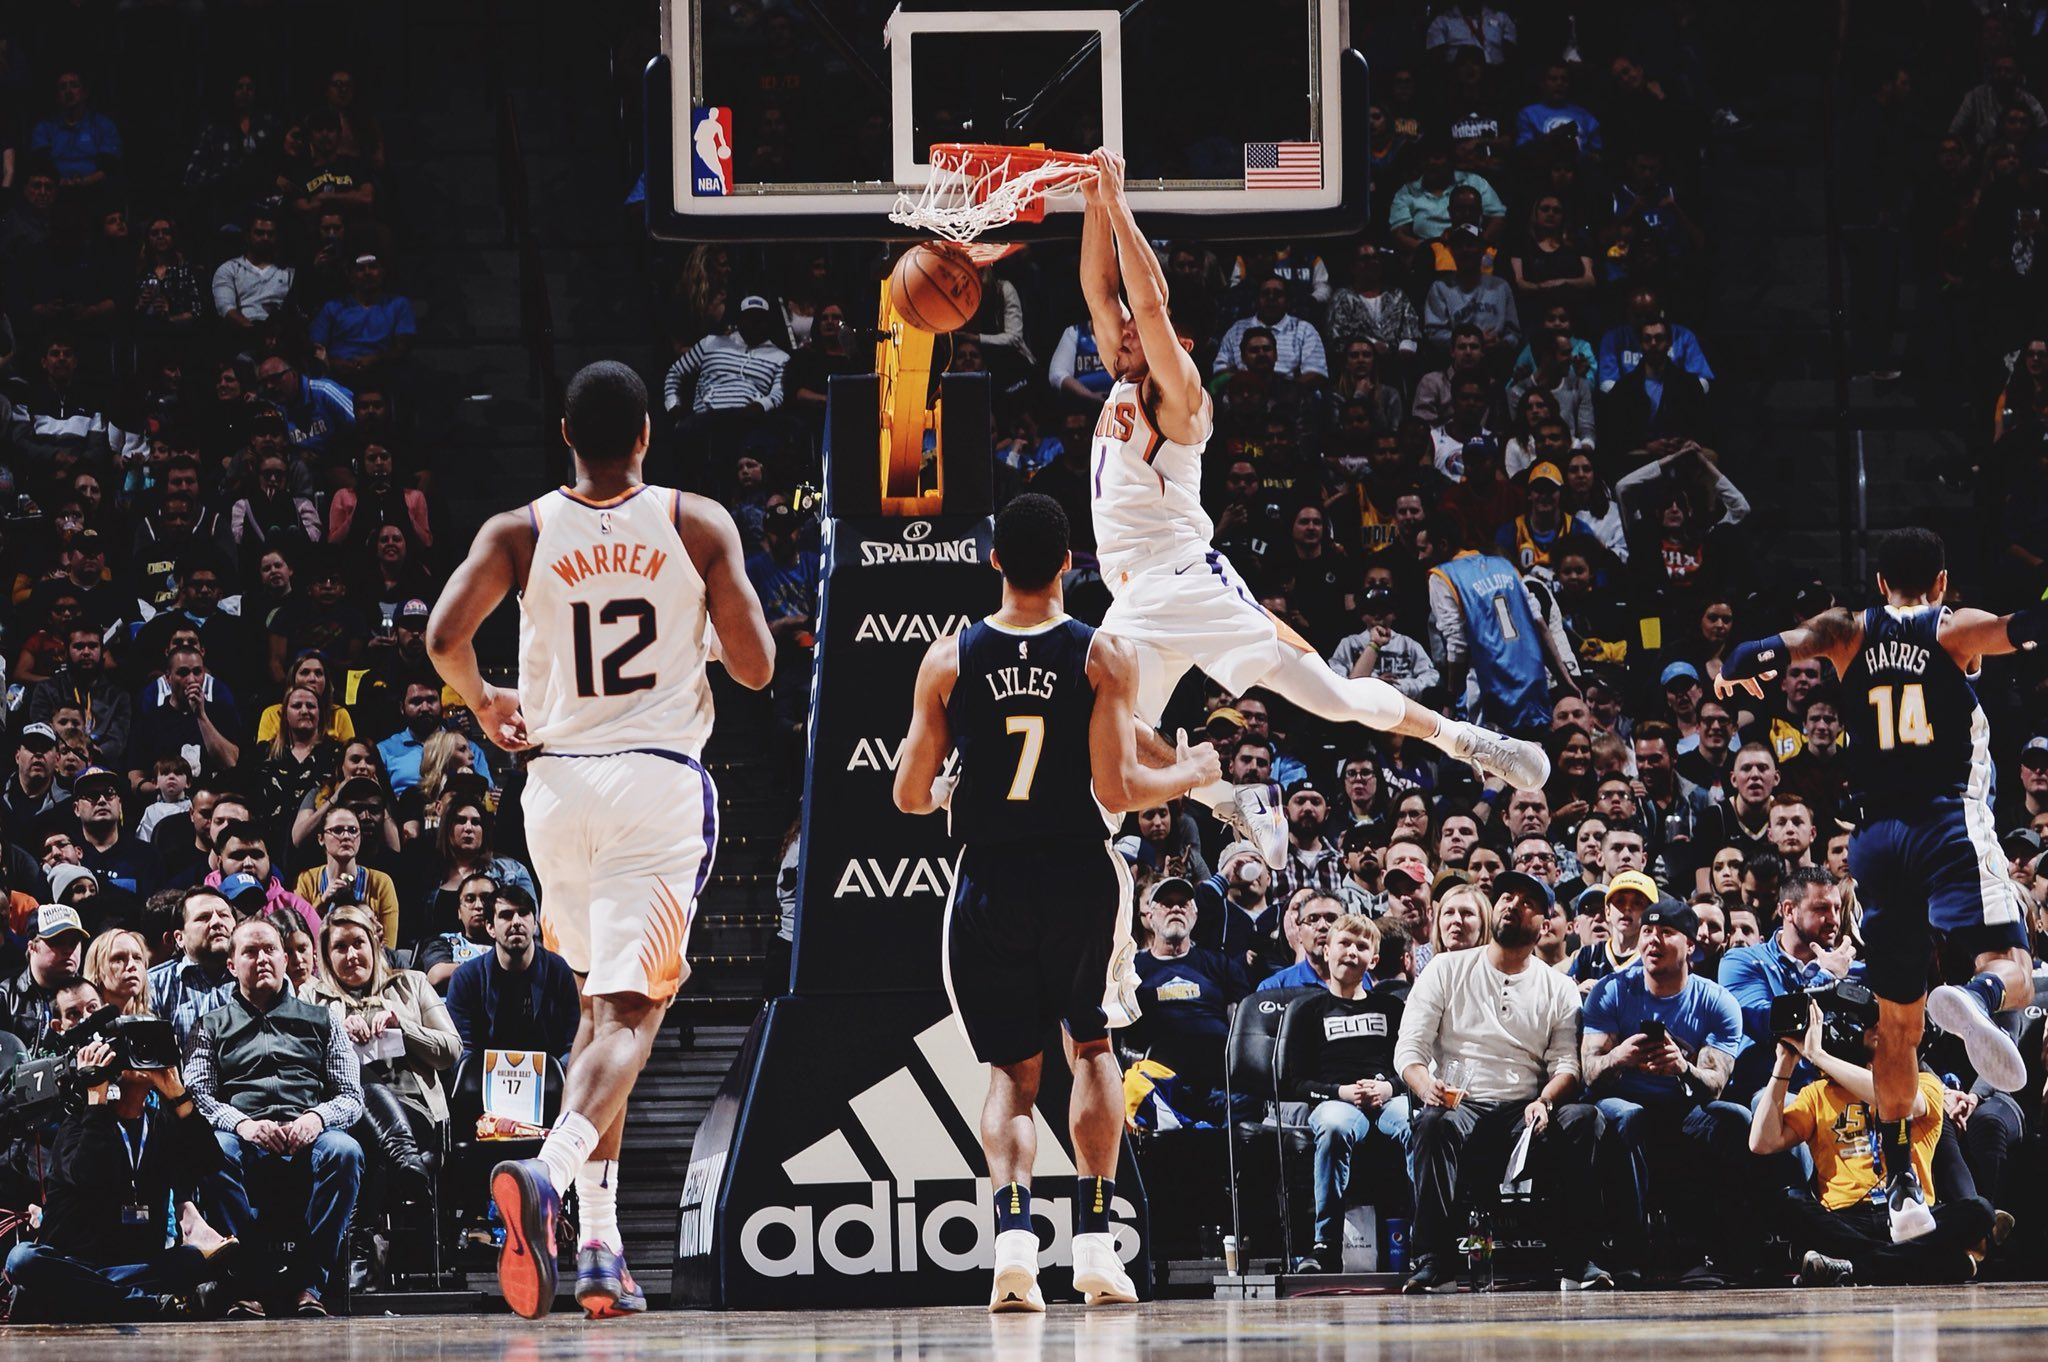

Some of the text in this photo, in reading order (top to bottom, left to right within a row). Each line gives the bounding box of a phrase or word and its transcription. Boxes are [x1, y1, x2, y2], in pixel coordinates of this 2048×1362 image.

[698, 177, 721, 191] NBA
[551, 543, 667, 587] WARREN
[860, 538, 979, 567] SPALDING
[1472, 574, 1515, 597] BILLUPS
[1493, 596, 1518, 639] 1
[569, 598, 657, 698] 12
[1865, 640, 1930, 676] HARRIS
[985, 667, 1057, 701] LYLES
[1868, 684, 1935, 752] 14
[1005, 714, 1045, 801] 7
[1776, 737, 1796, 756] 15
[1328, 1017, 1385, 1037] ELITE
[33, 1071, 44, 1092] 7
